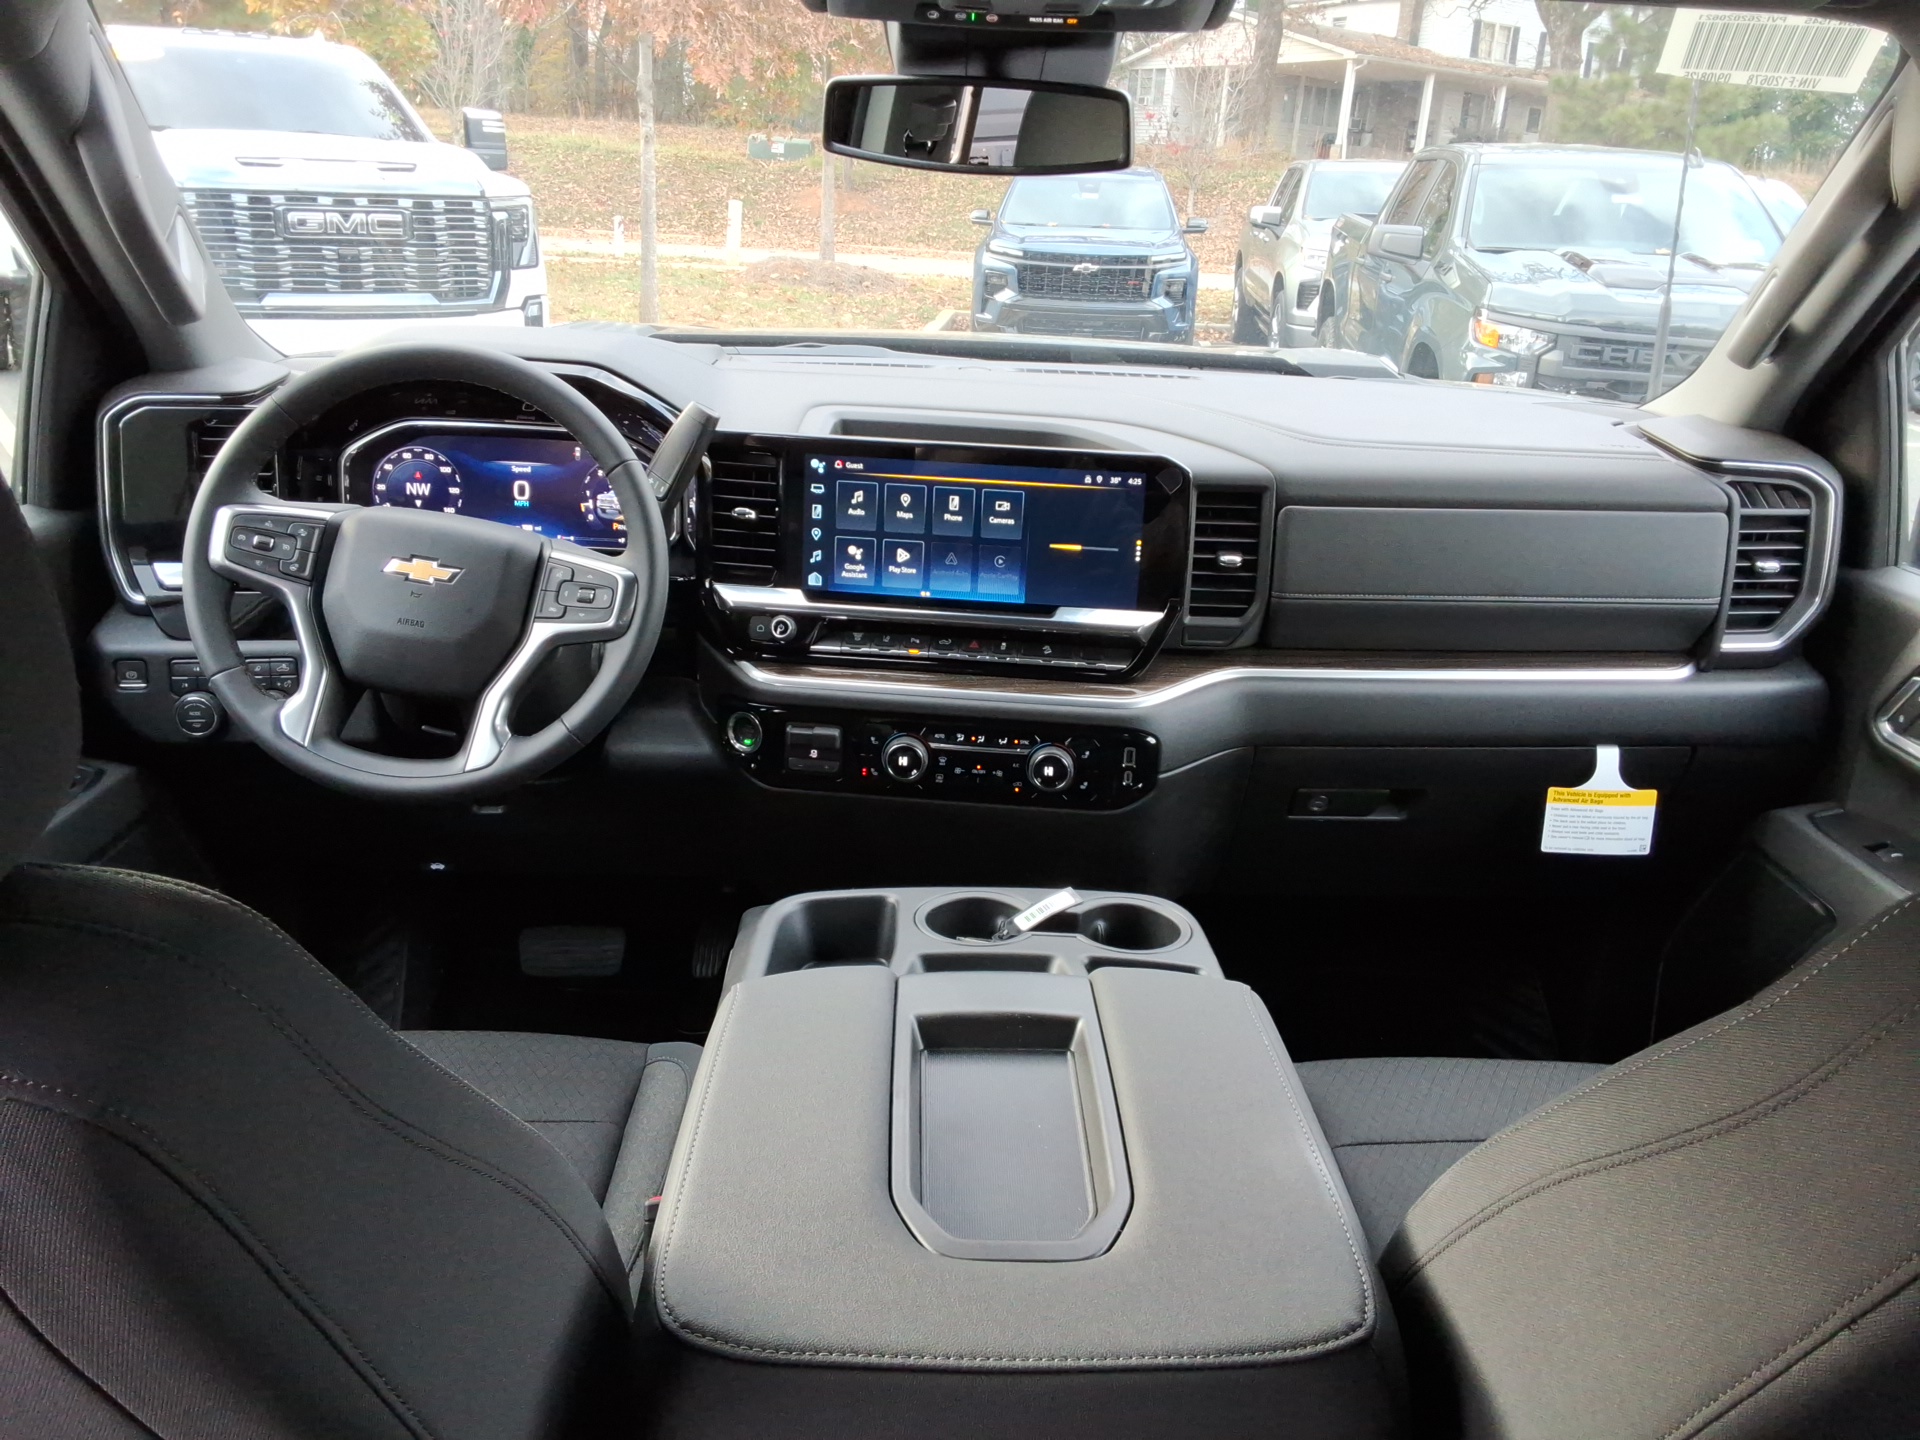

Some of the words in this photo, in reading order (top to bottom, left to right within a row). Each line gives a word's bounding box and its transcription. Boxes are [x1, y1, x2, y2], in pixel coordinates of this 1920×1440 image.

[288, 210, 404, 236] GMC
[511, 465, 532, 474] Speed
[845, 461, 864, 470] Guest
[1127, 477, 1143, 486] 4:25
[405, 481, 431, 497] NW
[512, 479, 530, 501] 0
[847, 507, 866, 516] Audio
[896, 510, 914, 520] Maps
[943, 513, 963, 522] Phone
[988, 516, 1015, 525] Cameras
[844, 563, 865, 572] Google
[888, 565, 902, 575] Play
[901, 566, 917, 575] Store
[841, 570, 868, 579] Assistant
[397, 617, 425, 629] AIRBAG
